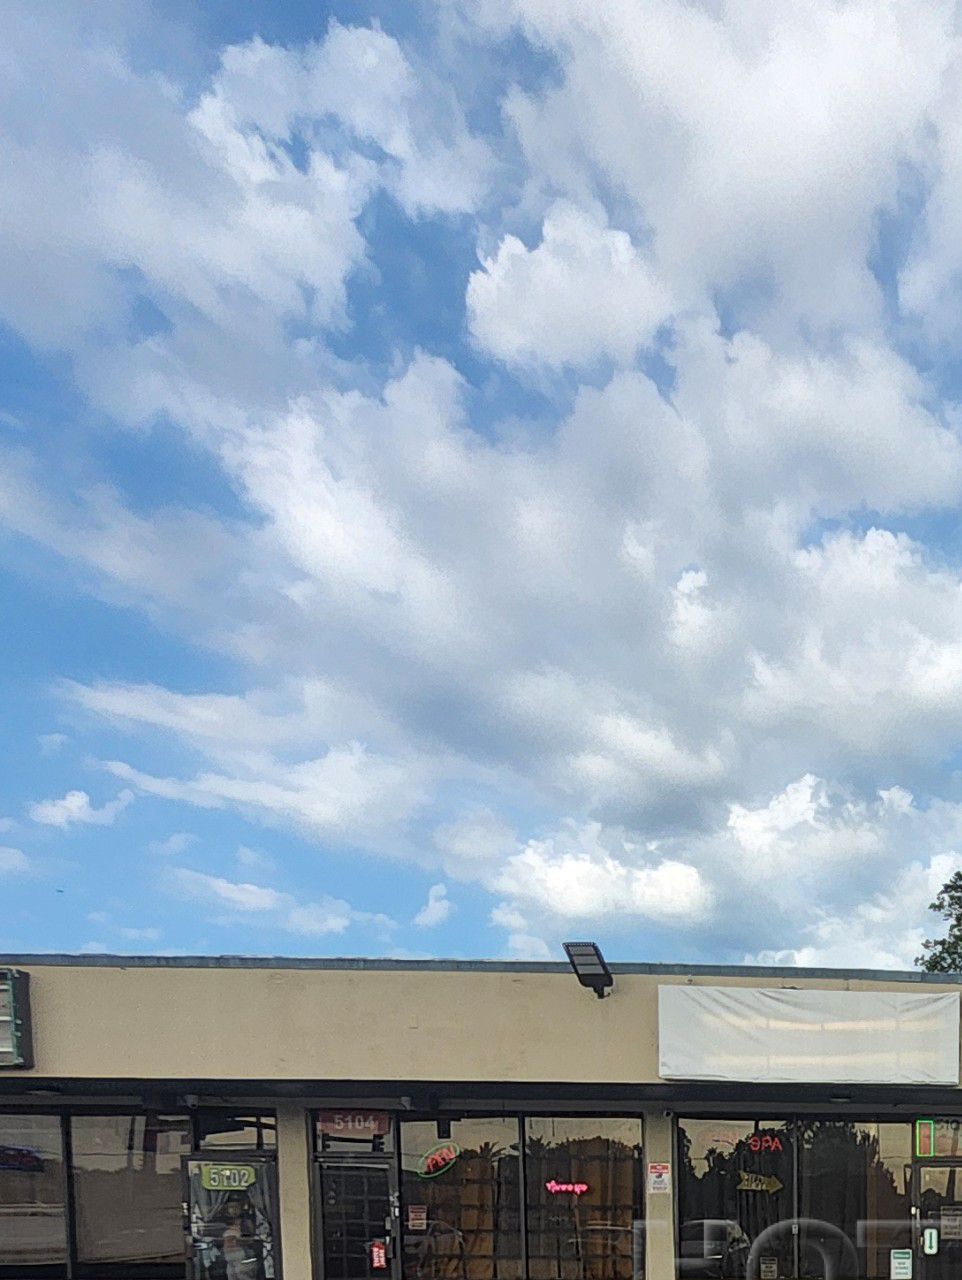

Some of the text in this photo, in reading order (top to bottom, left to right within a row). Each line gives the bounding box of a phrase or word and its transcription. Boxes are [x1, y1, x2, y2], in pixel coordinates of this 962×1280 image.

[334, 1114, 376, 1130] 5104
[749, 1135, 783, 1153] SPA
[210, 1169, 249, 1187] 5102
